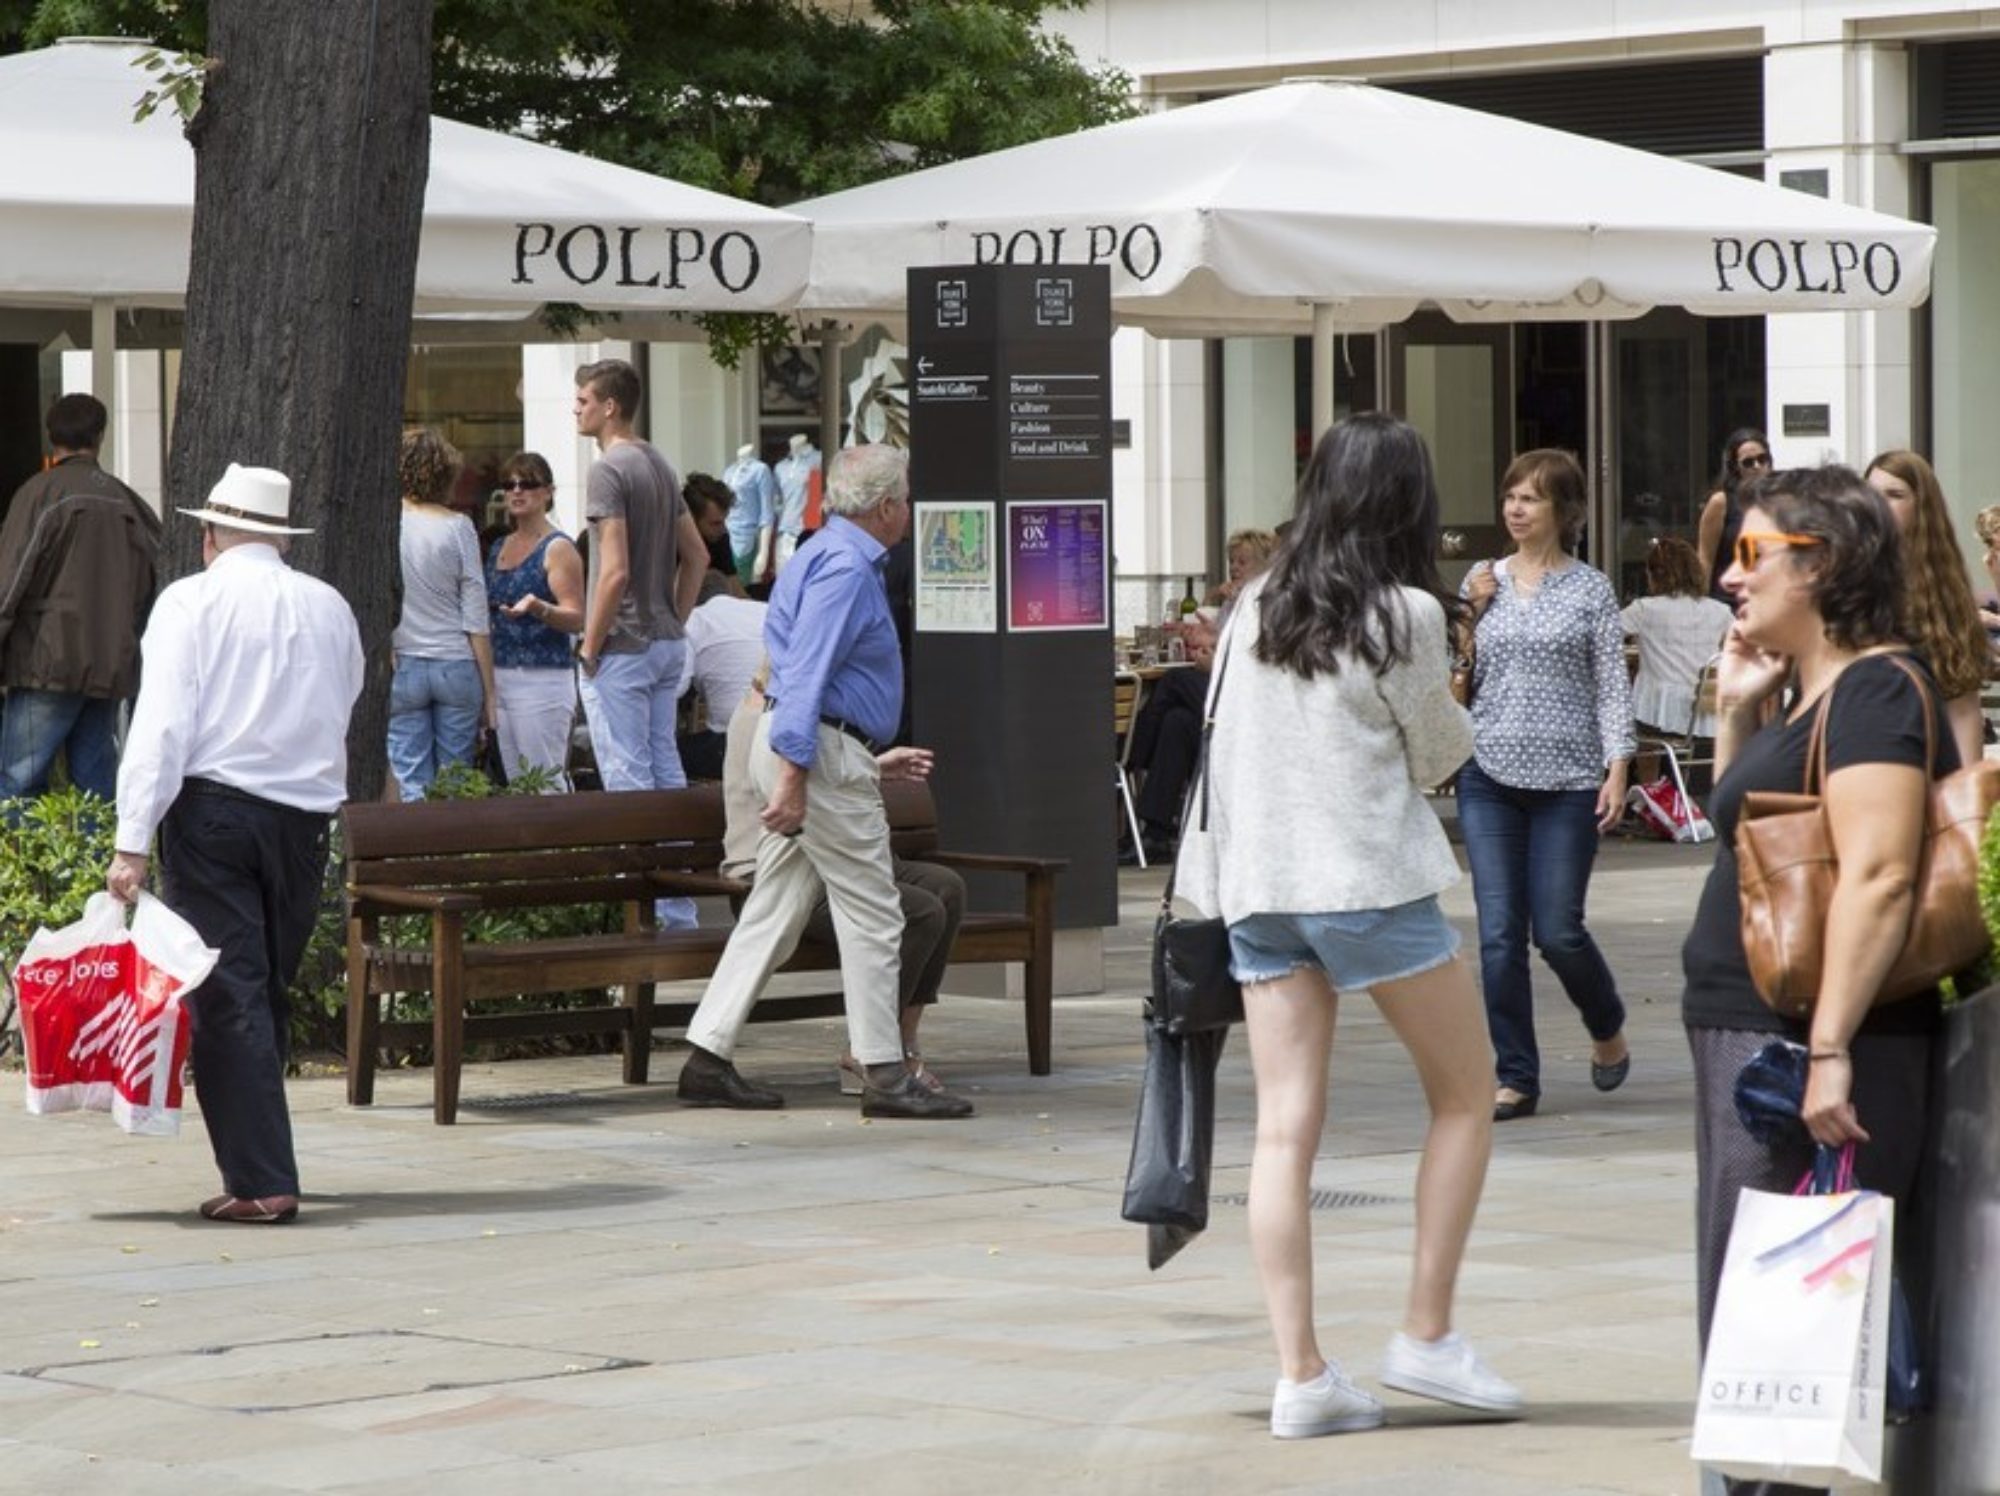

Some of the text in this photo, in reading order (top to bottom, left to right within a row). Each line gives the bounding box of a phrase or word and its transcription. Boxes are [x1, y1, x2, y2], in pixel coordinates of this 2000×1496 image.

[511, 222, 761, 294] POLPO
[1711, 237, 1900, 296] POLPO
[1010, 382, 1046, 396] Beauty
[1010, 402, 1050, 413] Culture
[1010, 421, 1050, 434] Fashion
[1010, 440, 1089, 454] Food and Drink
[1711, 1381, 1823, 1406] OFFICE
